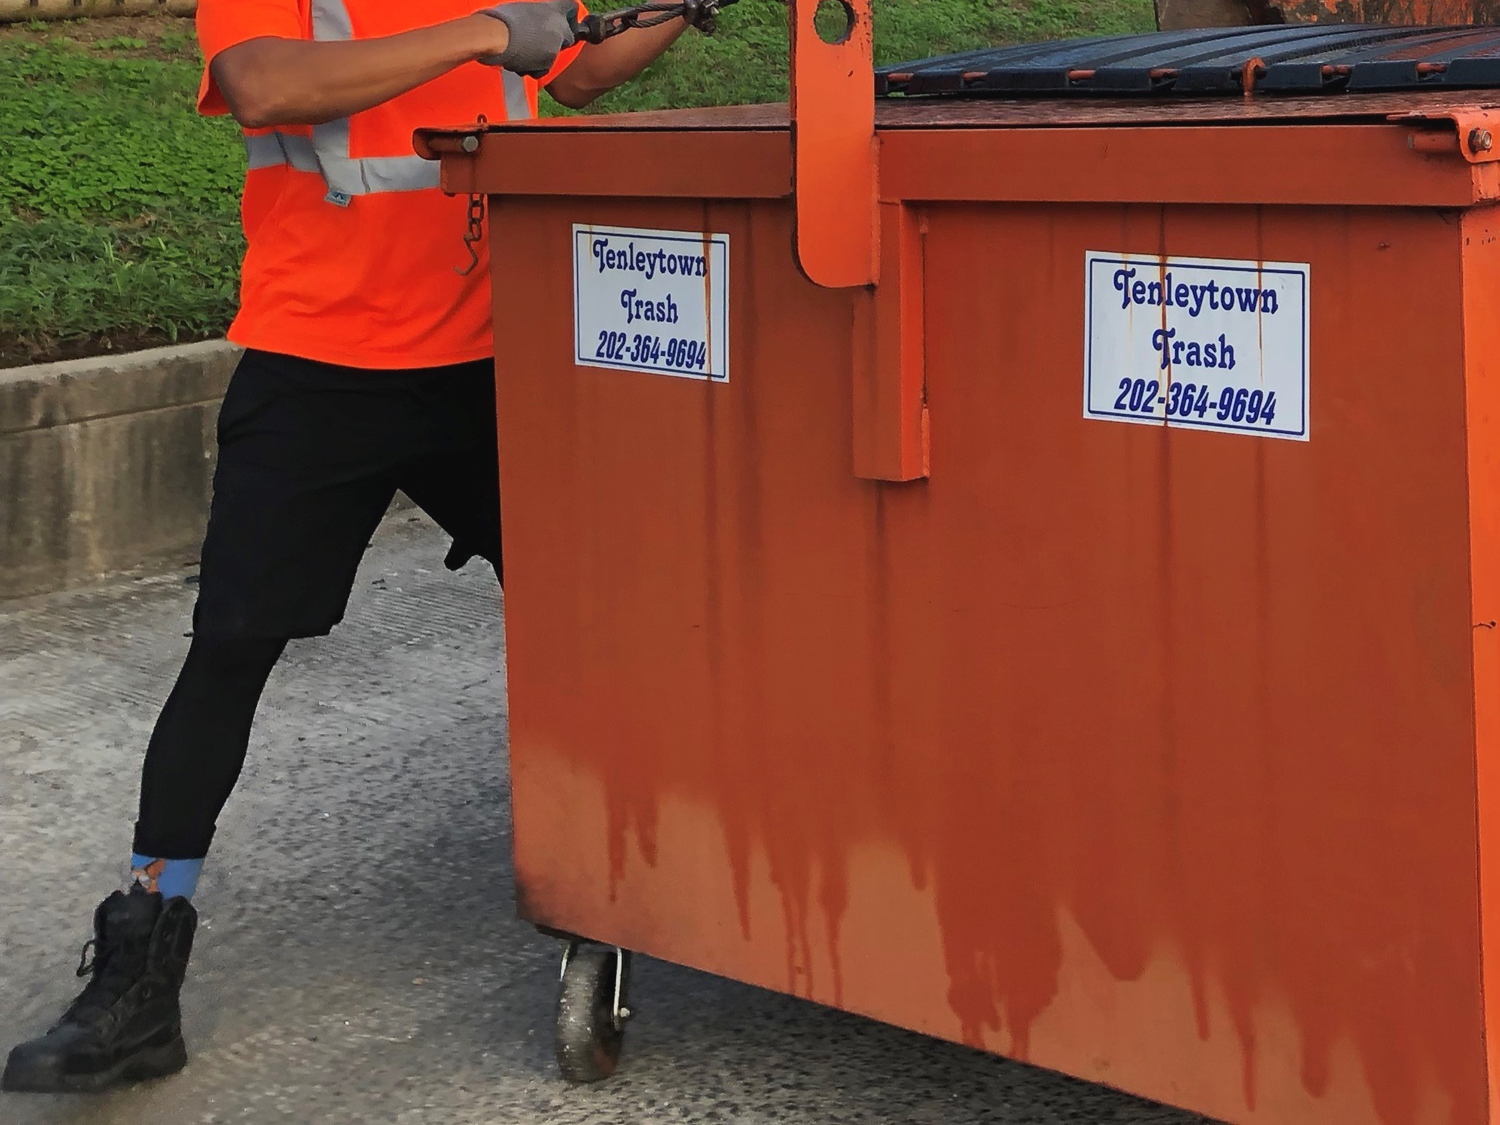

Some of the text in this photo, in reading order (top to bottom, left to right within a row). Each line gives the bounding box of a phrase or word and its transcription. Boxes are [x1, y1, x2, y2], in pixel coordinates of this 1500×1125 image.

[592, 238, 708, 280] Tenleytown
[620, 288, 679, 324] Trash
[1113, 267, 1279, 317] Tenleytown
[595, 329, 707, 370] 202-364-9694
[1152, 327, 1236, 370] Trash
[1113, 377, 1277, 425] 202-364-9694
